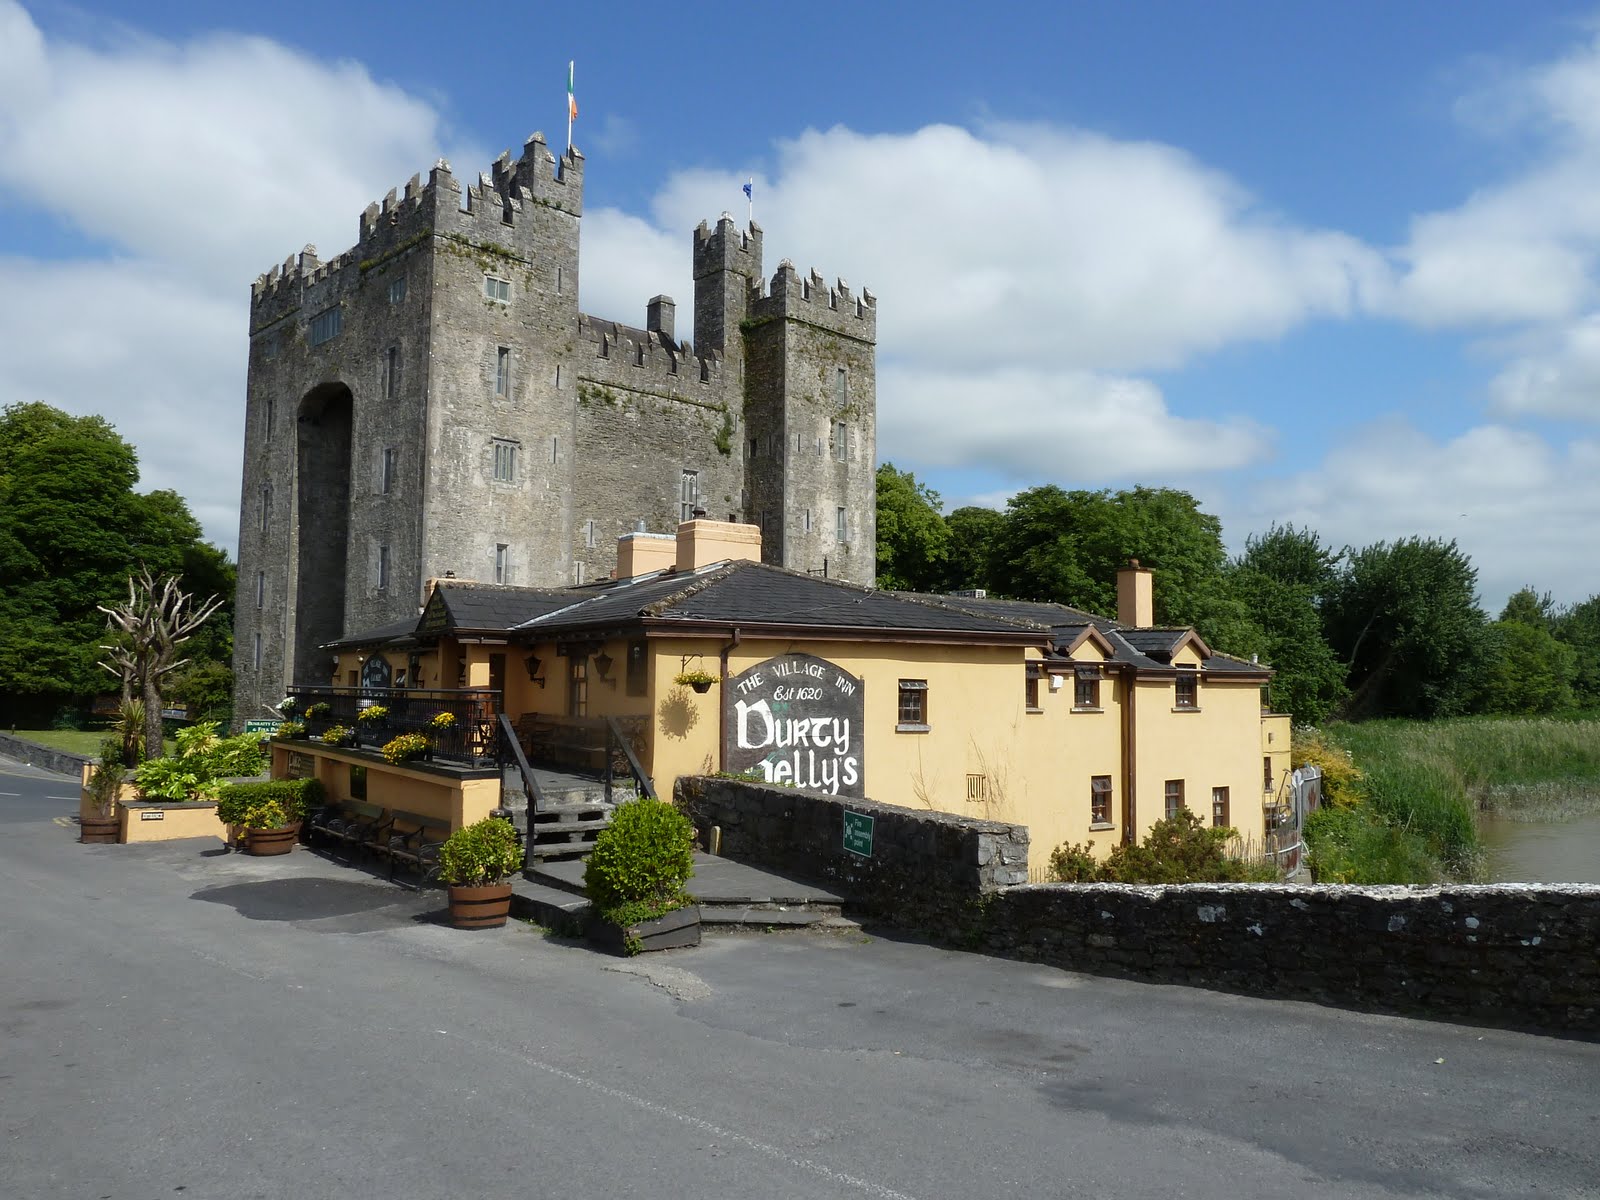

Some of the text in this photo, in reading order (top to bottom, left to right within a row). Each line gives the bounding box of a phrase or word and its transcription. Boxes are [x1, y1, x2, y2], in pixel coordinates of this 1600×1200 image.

[737, 661, 856, 697] THE VILLAGE INN
[774, 685, 823, 701] Est 1620
